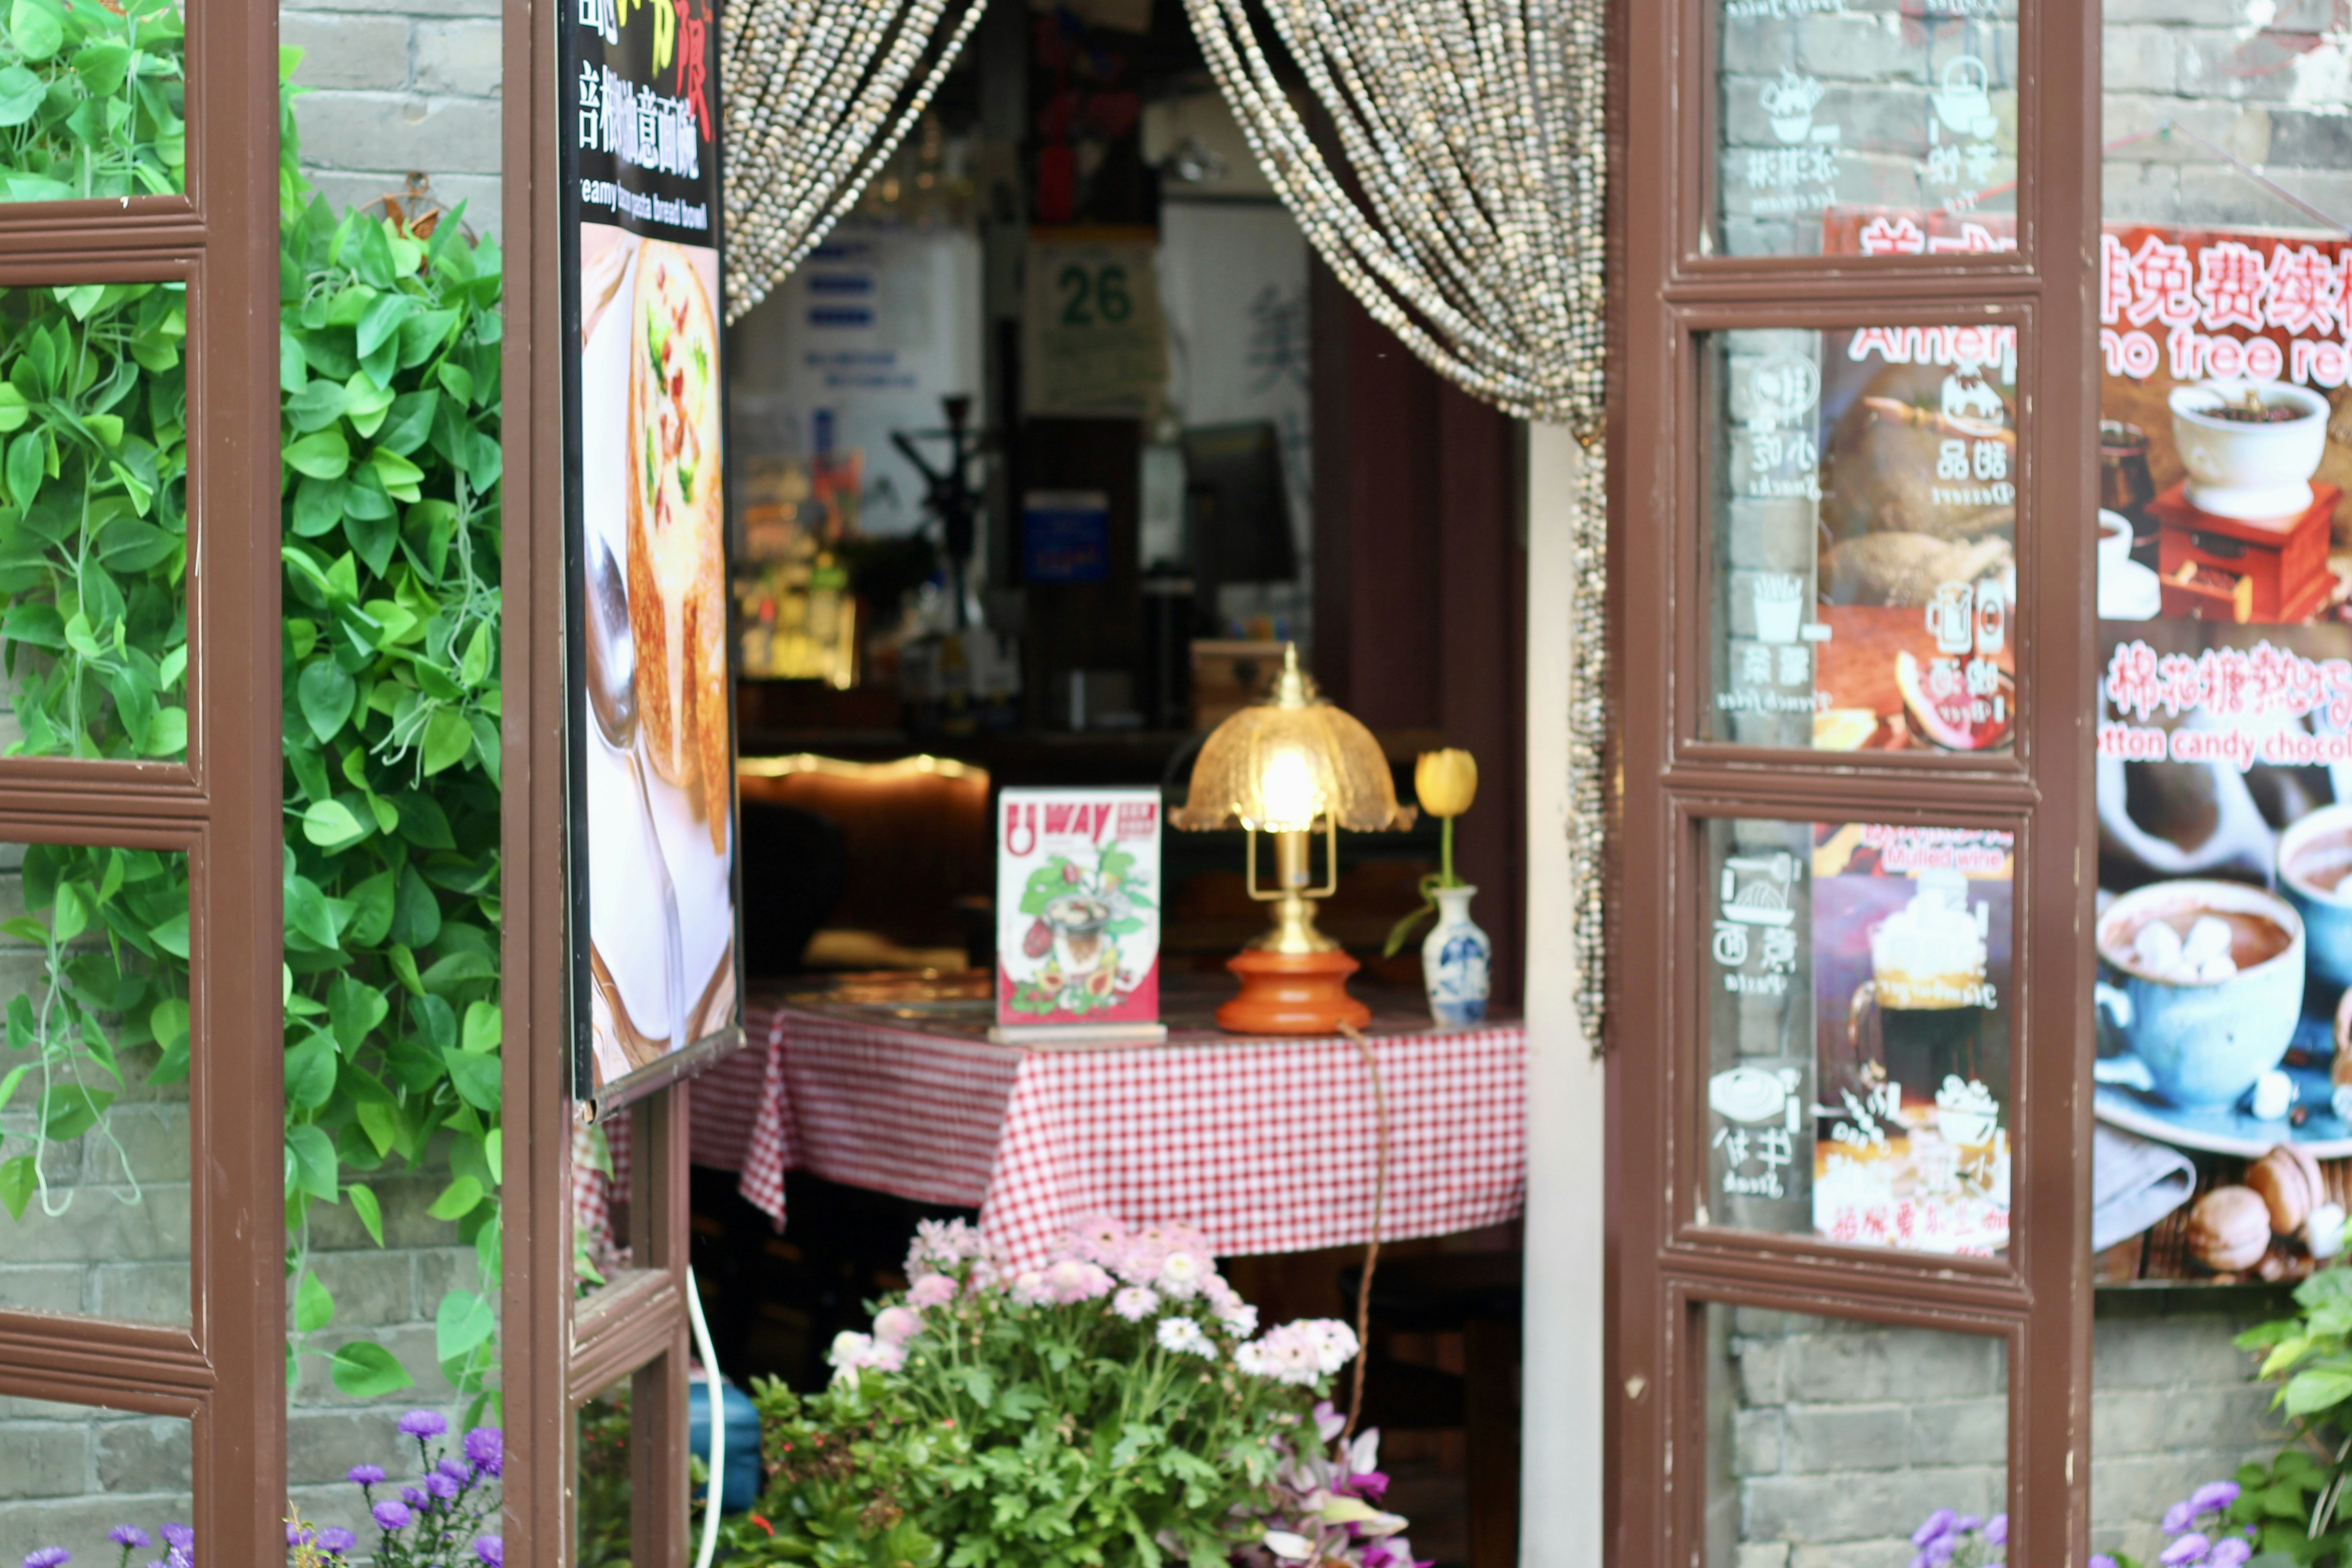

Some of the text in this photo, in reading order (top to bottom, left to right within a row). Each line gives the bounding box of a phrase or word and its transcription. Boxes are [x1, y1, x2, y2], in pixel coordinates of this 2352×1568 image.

[580, 179, 618, 213] eamy
[653, 193, 681, 226] bread
[681, 199, 708, 231] bowl
[1059, 266, 1132, 325] 26
[2167, 327, 2283, 384] free
[2096, 720, 2167, 762] tton
[2169, 726, 2256, 773] candy
[1885, 844, 2004, 870] Mulled wine
